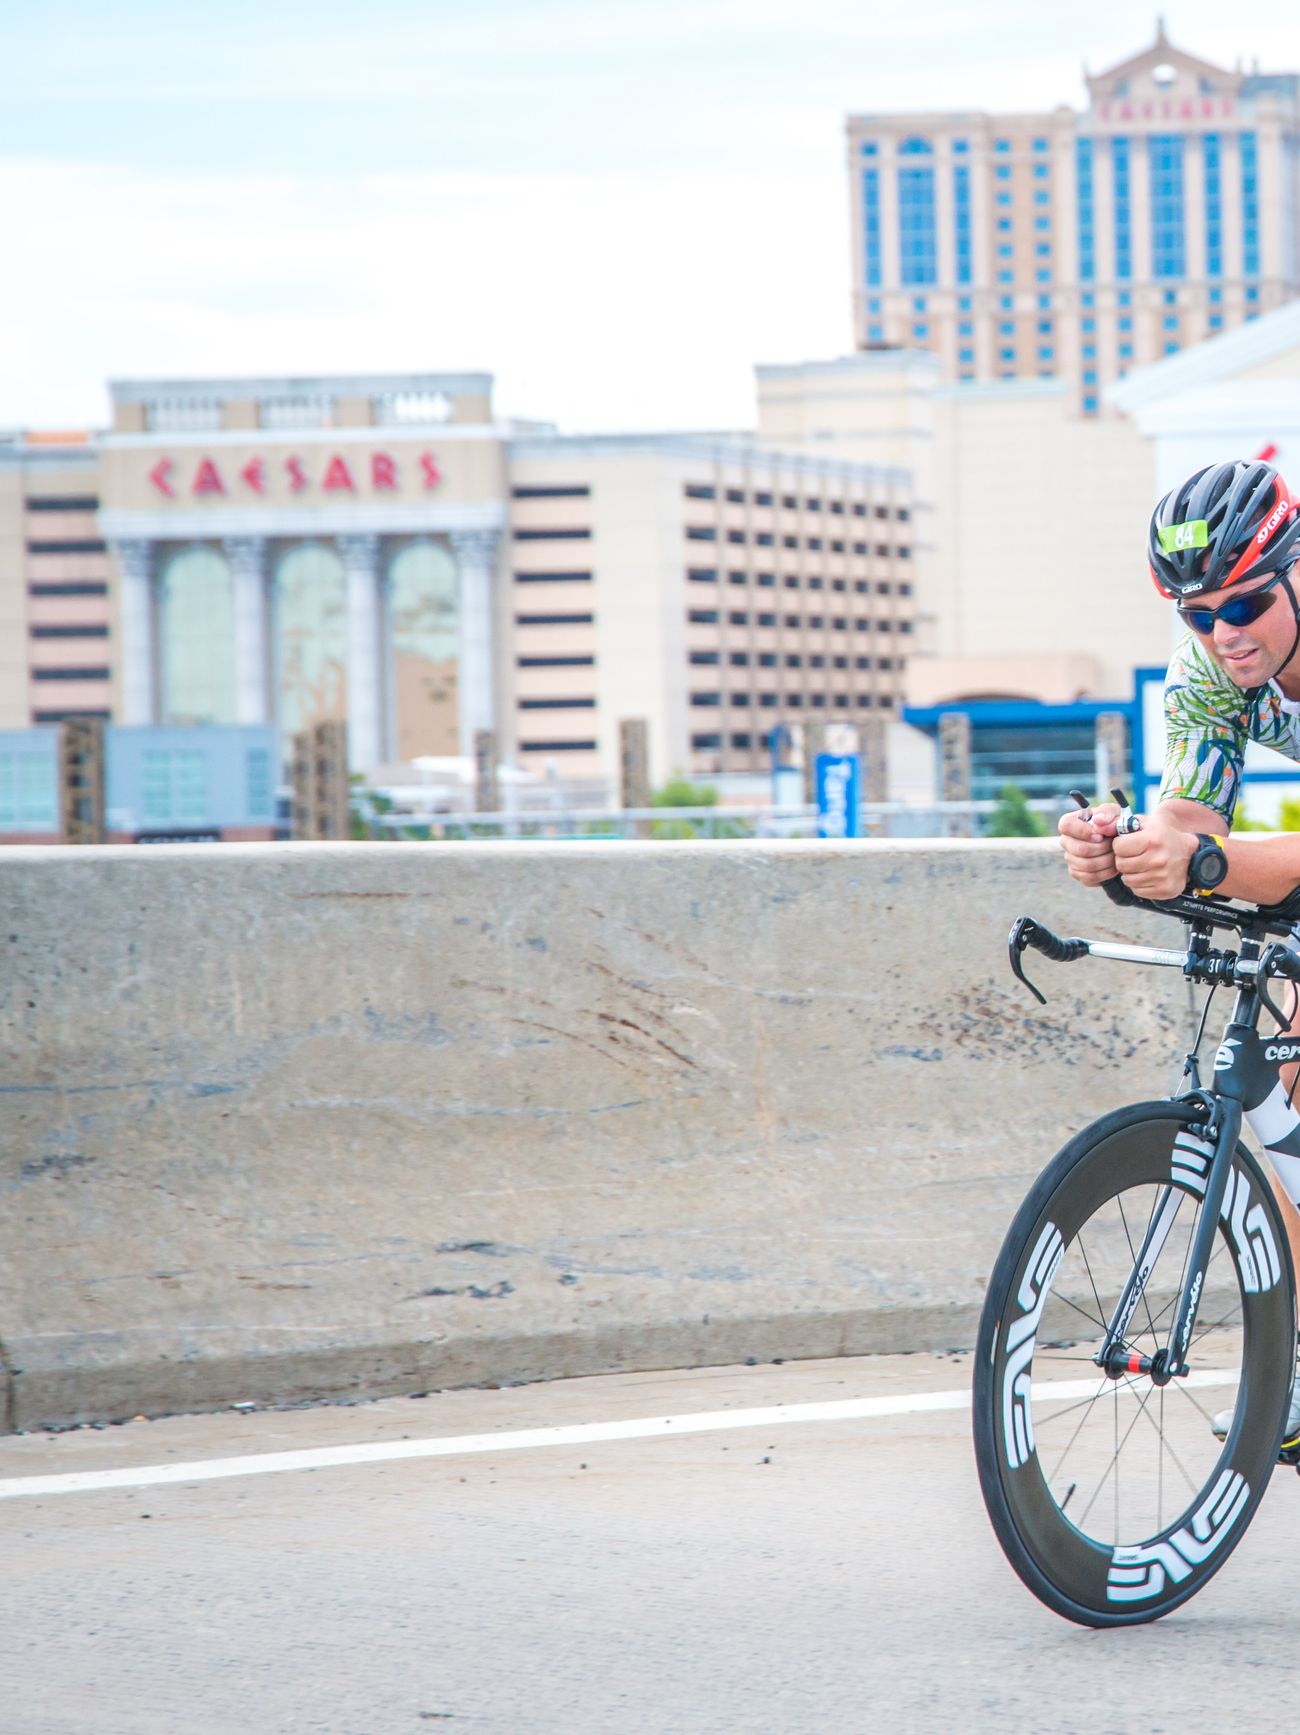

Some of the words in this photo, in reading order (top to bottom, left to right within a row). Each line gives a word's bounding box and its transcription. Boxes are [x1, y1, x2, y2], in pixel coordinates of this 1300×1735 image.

[149, 449, 441, 497] CAESARS
[1267, 501, 1289, 531] GIRO
[1175, 524, 1195, 548] 84
[1181, 582, 1203, 595] GIRO
